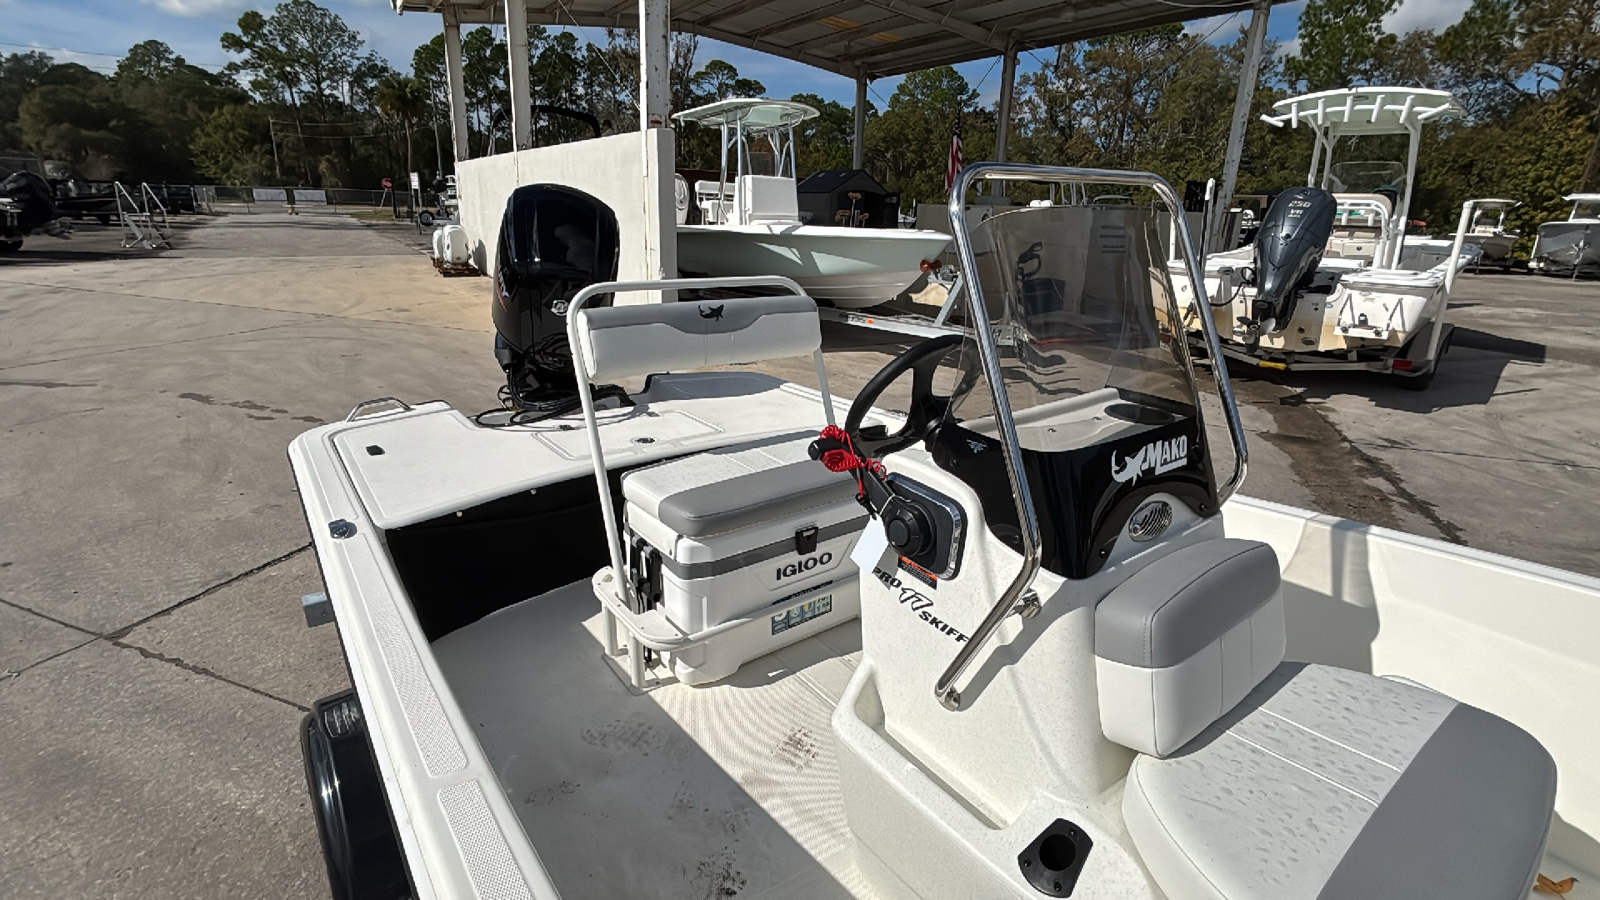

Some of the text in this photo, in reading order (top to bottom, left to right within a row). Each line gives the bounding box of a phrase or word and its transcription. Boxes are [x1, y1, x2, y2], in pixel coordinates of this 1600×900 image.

[1288, 200, 1312, 208] 250
[1141, 434, 1188, 476] MAKO
[776, 552, 832, 581] IGLOO
[871, 566, 902, 588] PRO
[899, 587, 934, 612] 17
[918, 610, 970, 643] SKIFF
